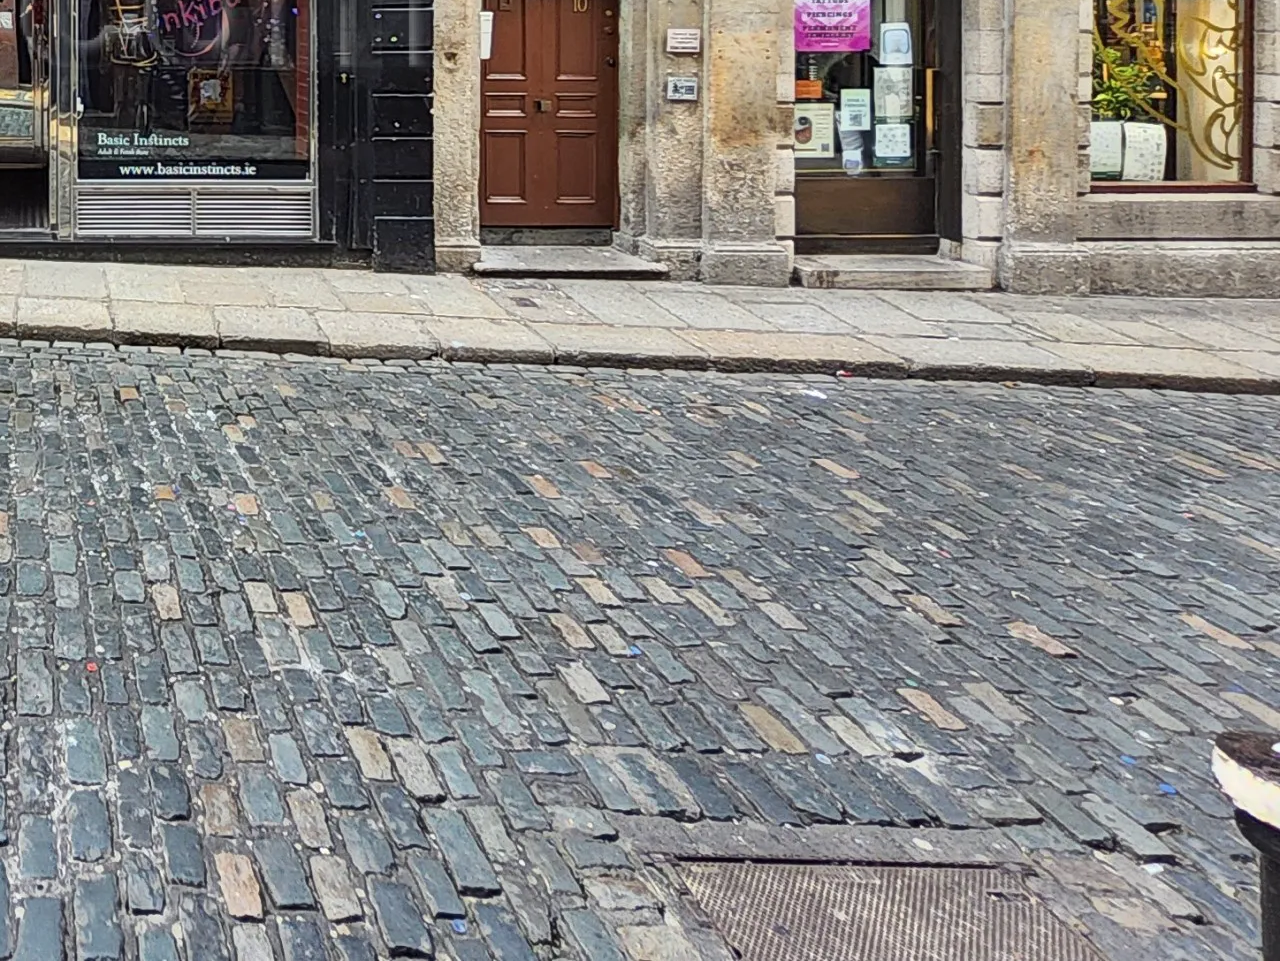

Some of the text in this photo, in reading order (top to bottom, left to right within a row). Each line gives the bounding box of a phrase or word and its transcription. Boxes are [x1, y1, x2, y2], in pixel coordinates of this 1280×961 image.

[97, 132, 190, 146] Basic Instincts
[119, 162, 257, 176] www.basicinstincts.ie
